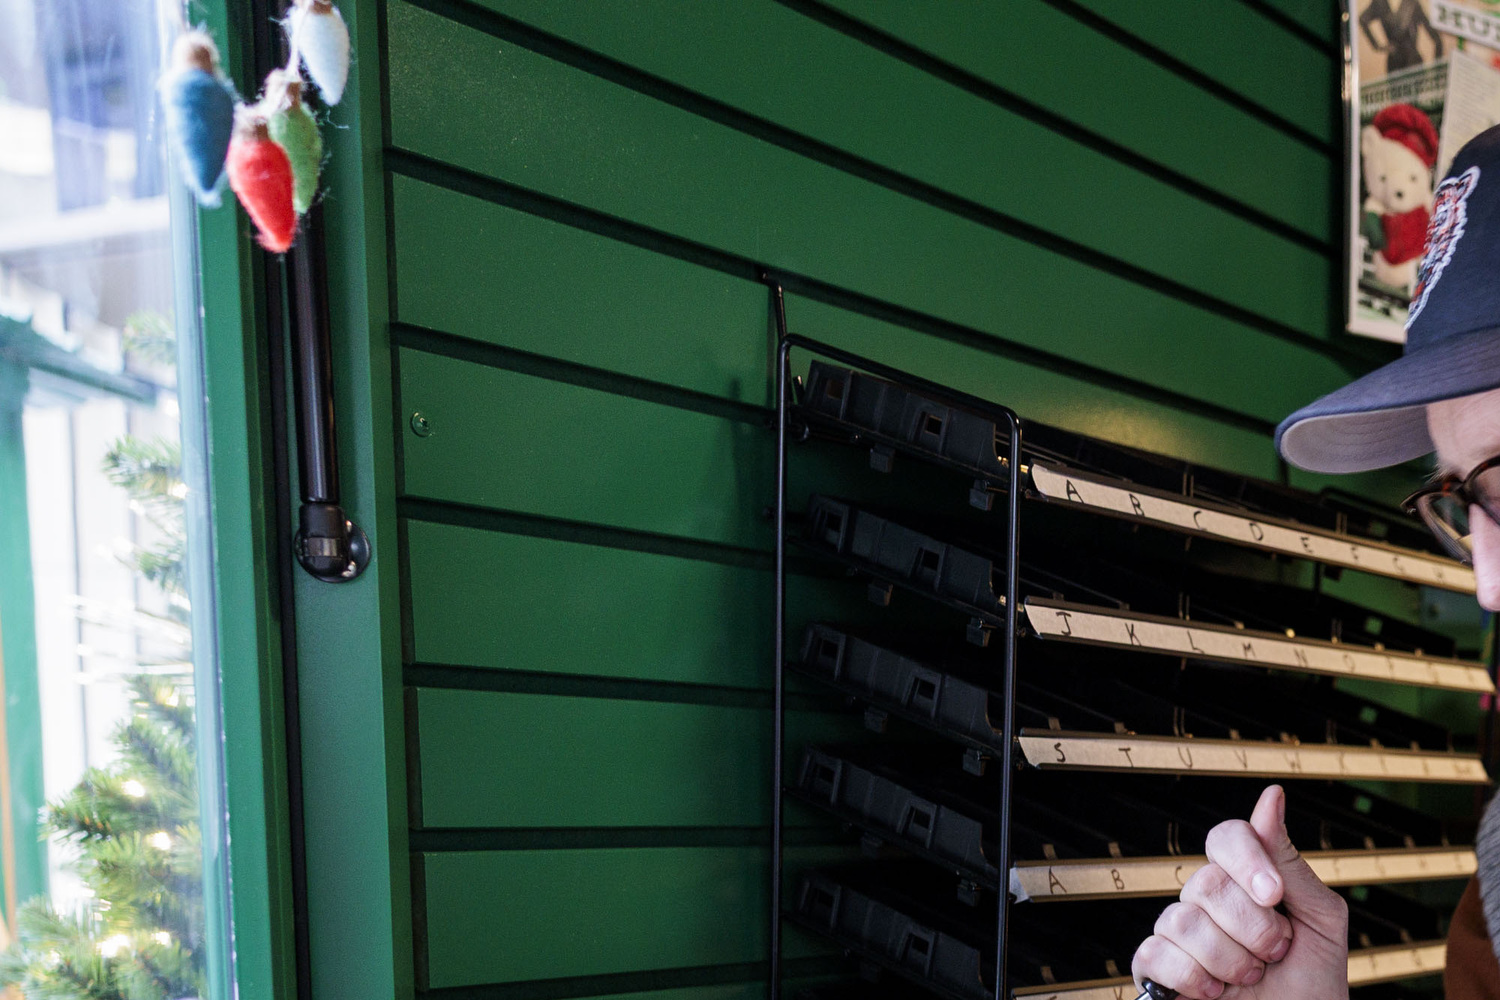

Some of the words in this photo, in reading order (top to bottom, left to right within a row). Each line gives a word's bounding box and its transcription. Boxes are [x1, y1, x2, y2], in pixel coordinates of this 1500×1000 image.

[1066, 479, 1084, 503] A
[1129, 493, 1145, 516] B
[1193, 510, 1208, 531] C
[1249, 522, 1264, 541] D
[1056, 611, 1072, 636] J
[1125, 622, 1142, 646] K
[1187, 630, 1206, 654] L
[1242, 642, 1257, 659] M
[1053, 742, 1066, 763] S
[1118, 747, 1134, 768] T
[1178, 746, 1193, 770] U
[1233, 749, 1248, 769] V
[1048, 867, 1067, 895] A
[1111, 868, 1125, 890] B
